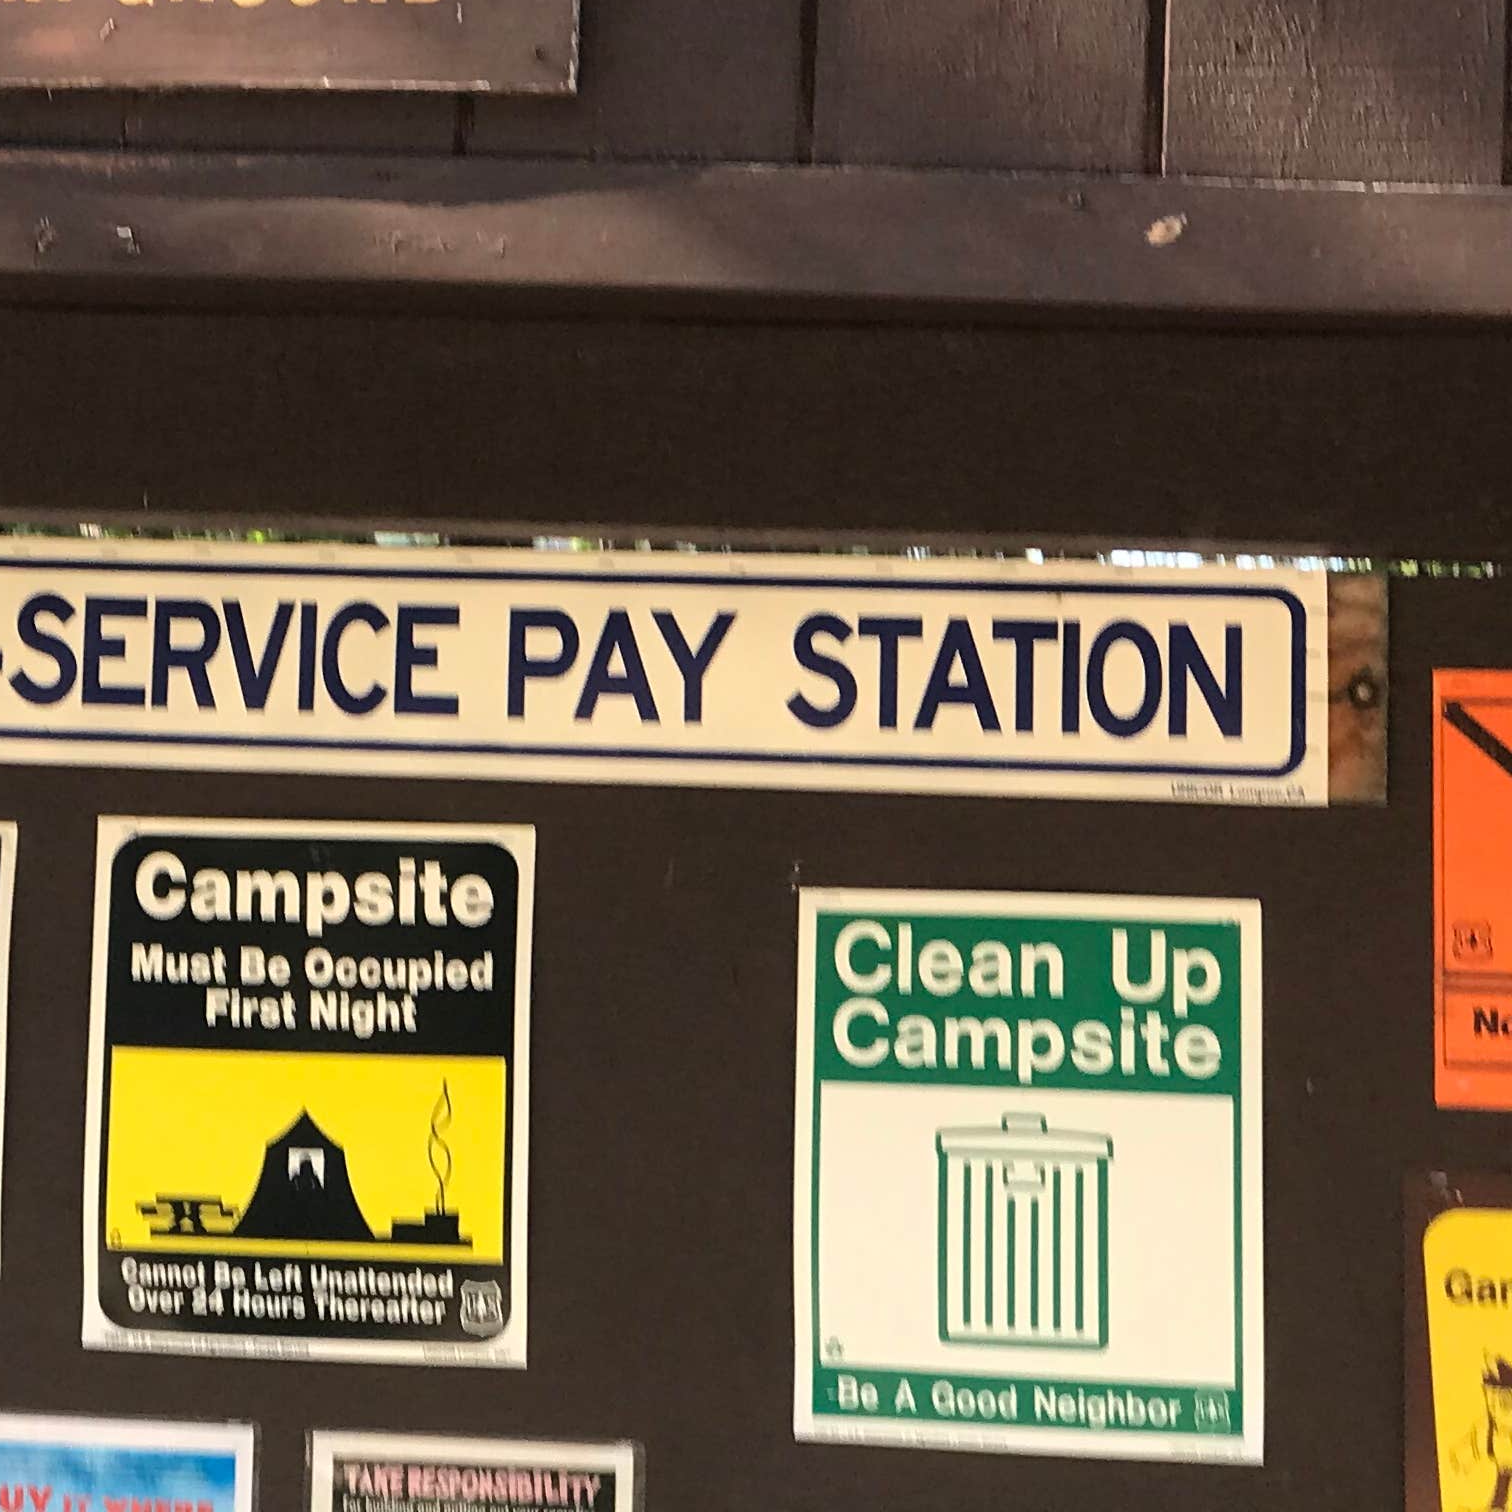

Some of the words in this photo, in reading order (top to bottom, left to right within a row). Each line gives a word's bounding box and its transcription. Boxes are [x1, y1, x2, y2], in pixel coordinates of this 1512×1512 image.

[507, 606, 737, 724] PAY
[786, 612, 1243, 740] STATION
[136, 851, 494, 937] Campsite
[130, 942, 226, 984] Must
[240, 944, 291, 986] Be
[304, 946, 494, 997] Occupied
[834, 919, 1064, 999] Clean
[1111, 928, 1222, 1018] Up
[206, 989, 296, 1030] First
[309, 990, 417, 1039] Night
[833, 997, 1222, 1085] Campsite
[121, 1256, 206, 1288] Cannot
[215, 1260, 246, 1289] Be
[255, 1261, 303, 1293] Left
[311, 1264, 454, 1298] Unattended
[128, 1283, 184, 1315] Over
[233, 1288, 306, 1320] Hours
[314, 1288, 446, 1325] Thereafter
[838, 1374, 879, 1412] Be
[894, 1377, 918, 1415] A
[932, 1379, 1018, 1421] Good
[1034, 1384, 1182, 1430] Neighbor
[344, 1464, 404, 1497] TAKE
[408, 1466, 601, 1507] RESPONSIBILITY
